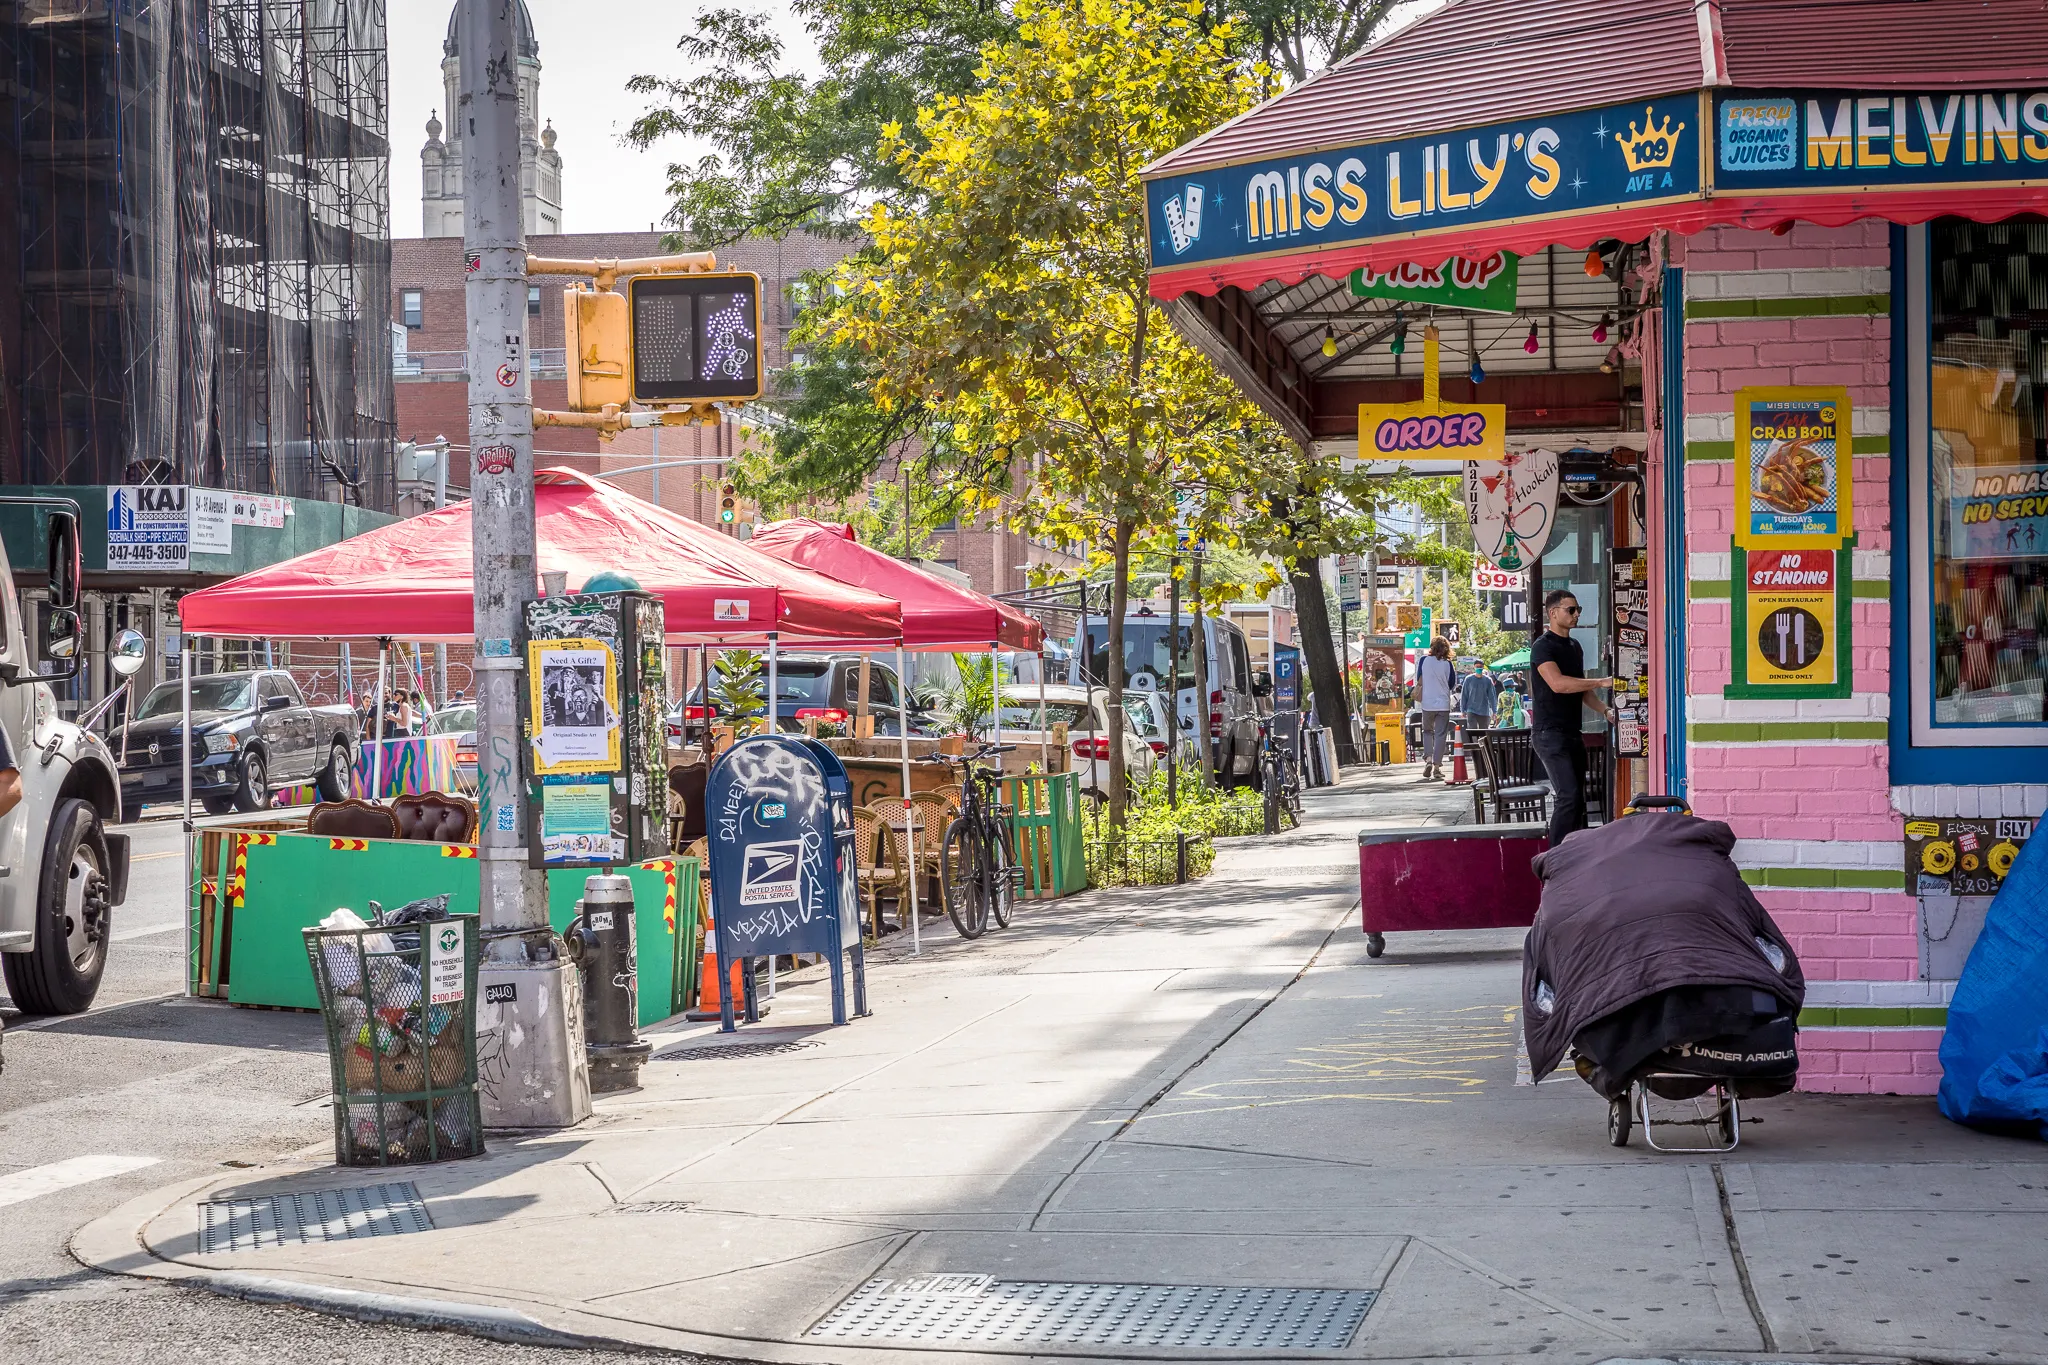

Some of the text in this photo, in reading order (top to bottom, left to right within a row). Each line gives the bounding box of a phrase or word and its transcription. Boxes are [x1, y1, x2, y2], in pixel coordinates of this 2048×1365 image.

[1727, 104, 1791, 127] FRESH
[1729, 128, 1788, 143] ORGANIC
[1804, 93, 2048, 170] MELVINS
[1631, 136, 1670, 163] 109
[1728, 144, 1789, 164] JUICES
[1246, 126, 1561, 243] MISS LILY'S
[1625, 172, 1674, 194] AVE A
[1773, 412, 1809, 431] Jerk
[1375, 412, 1487, 452] ORDER
[1751, 426, 1836, 439] CRAB BOIL
[1515, 461, 1558, 503] Hookah
[1973, 477, 2003, 498] NO
[137, 487, 185, 512] KAJ
[1774, 515, 1813, 523] TUESDAYS
[1962, 503, 1993, 525] NO
[1760, 523, 1774, 531] ALL
[1803, 523, 1827, 531] LONG
[109, 532, 134, 542] SIDEWALK
[134, 532, 147, 541] SHED
[151, 532, 161, 541] PIPE
[162, 532, 187, 541] SCAFFOLD
[109, 545, 187, 560] 347-445-3500
[1394, 556, 1399, 565] E
[1779, 554, 1801, 568] NO
[1477, 573, 1518, 588] 99¢
[1752, 571, 1829, 585] STANDING
[1504, 594, 1531, 623] dro
[1281, 662, 1290, 677] P
[2000, 822, 2028, 837] ISLY
[745, 886, 769, 894] UNITED
[769, 891, 795, 899] SERVICE
[591, 915, 612, 927] CROMA
[440, 957, 463, 965] HOUSEHOLD
[443, 973, 462, 981] BUSINESS
[432, 990, 463, 1003] $100 FINE
[1694, 1047, 1794, 1062] UNDER ARMOUR
